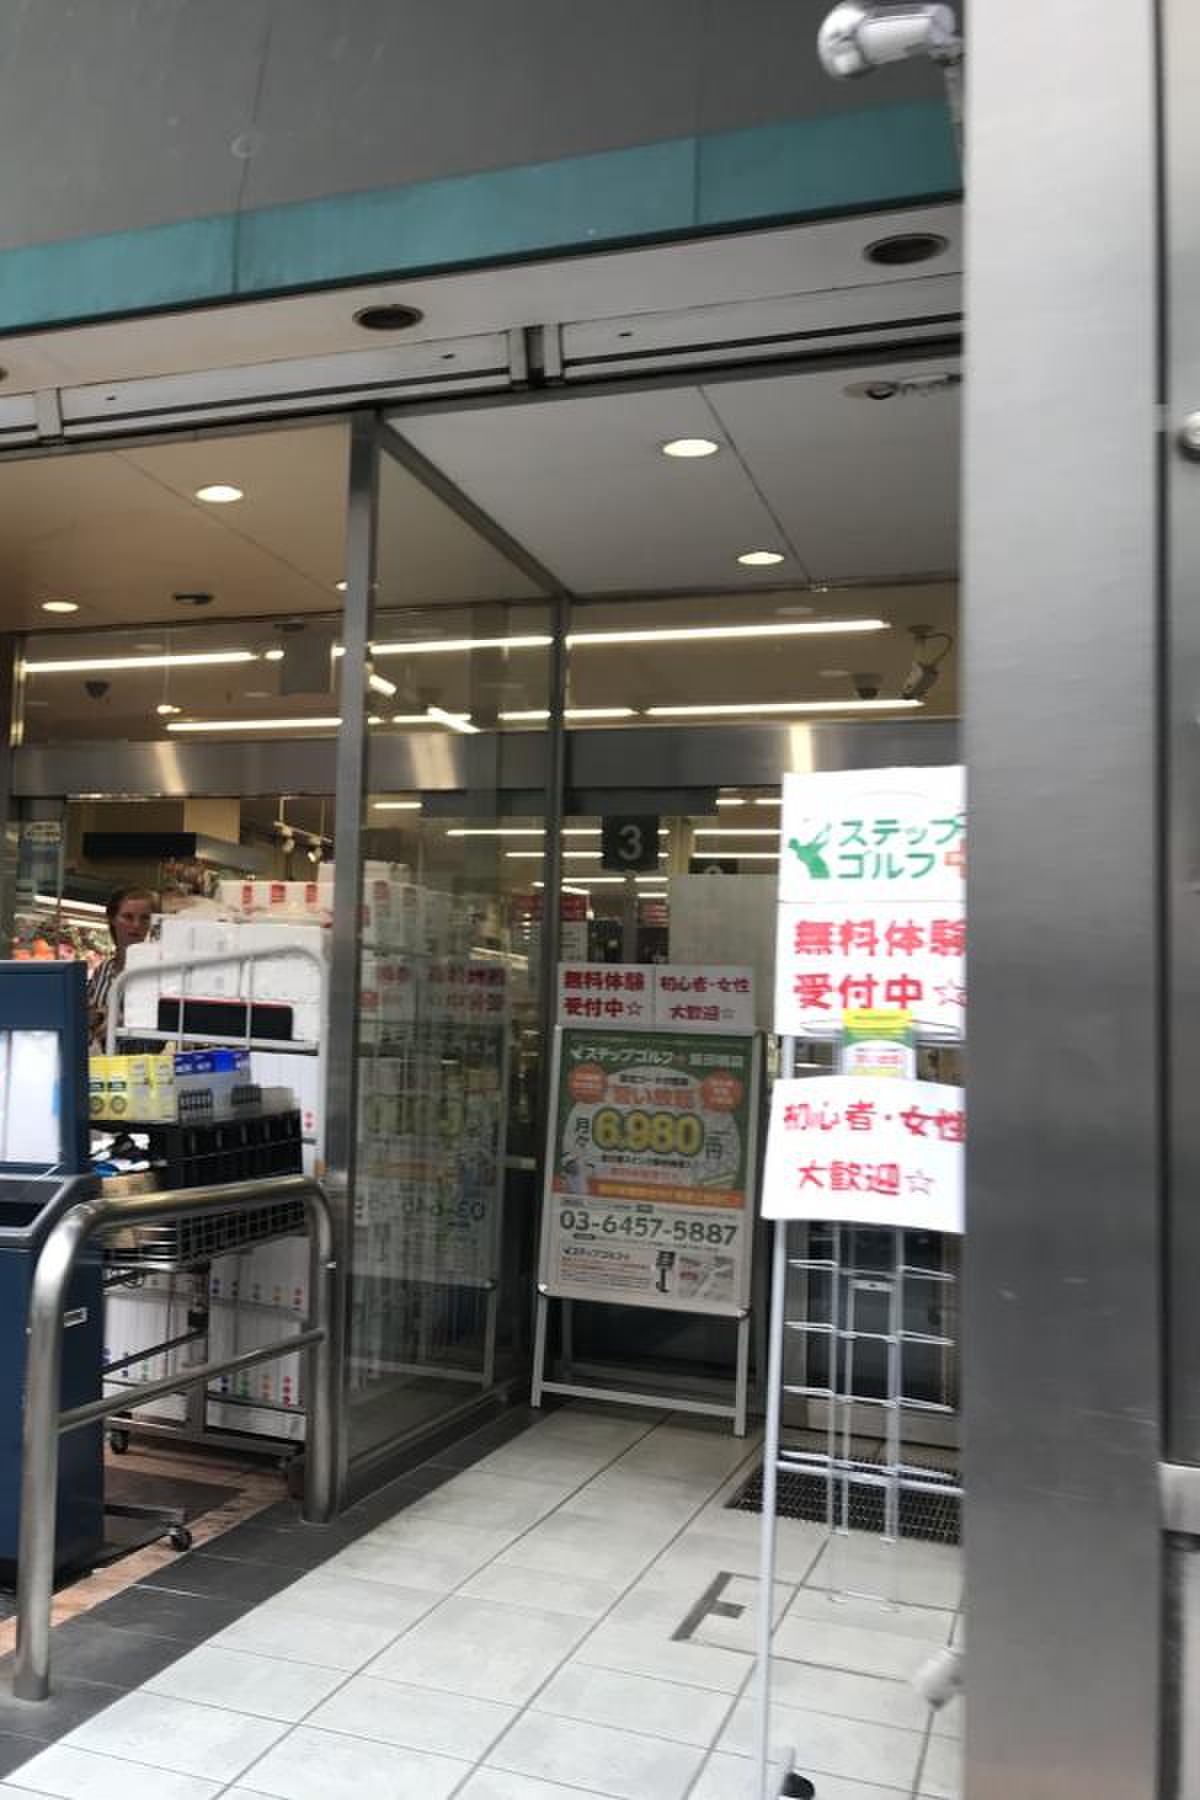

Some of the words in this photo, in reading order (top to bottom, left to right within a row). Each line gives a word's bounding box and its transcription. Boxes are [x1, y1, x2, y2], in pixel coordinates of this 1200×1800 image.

[619, 824, 642, 860] 3
[838, 849, 936, 880] ゴルフ
[795, 919, 966, 957] 無料体験
[794, 973, 924, 1010] 受付中
[560, 1210, 739, 1246] 03-6457-5887
